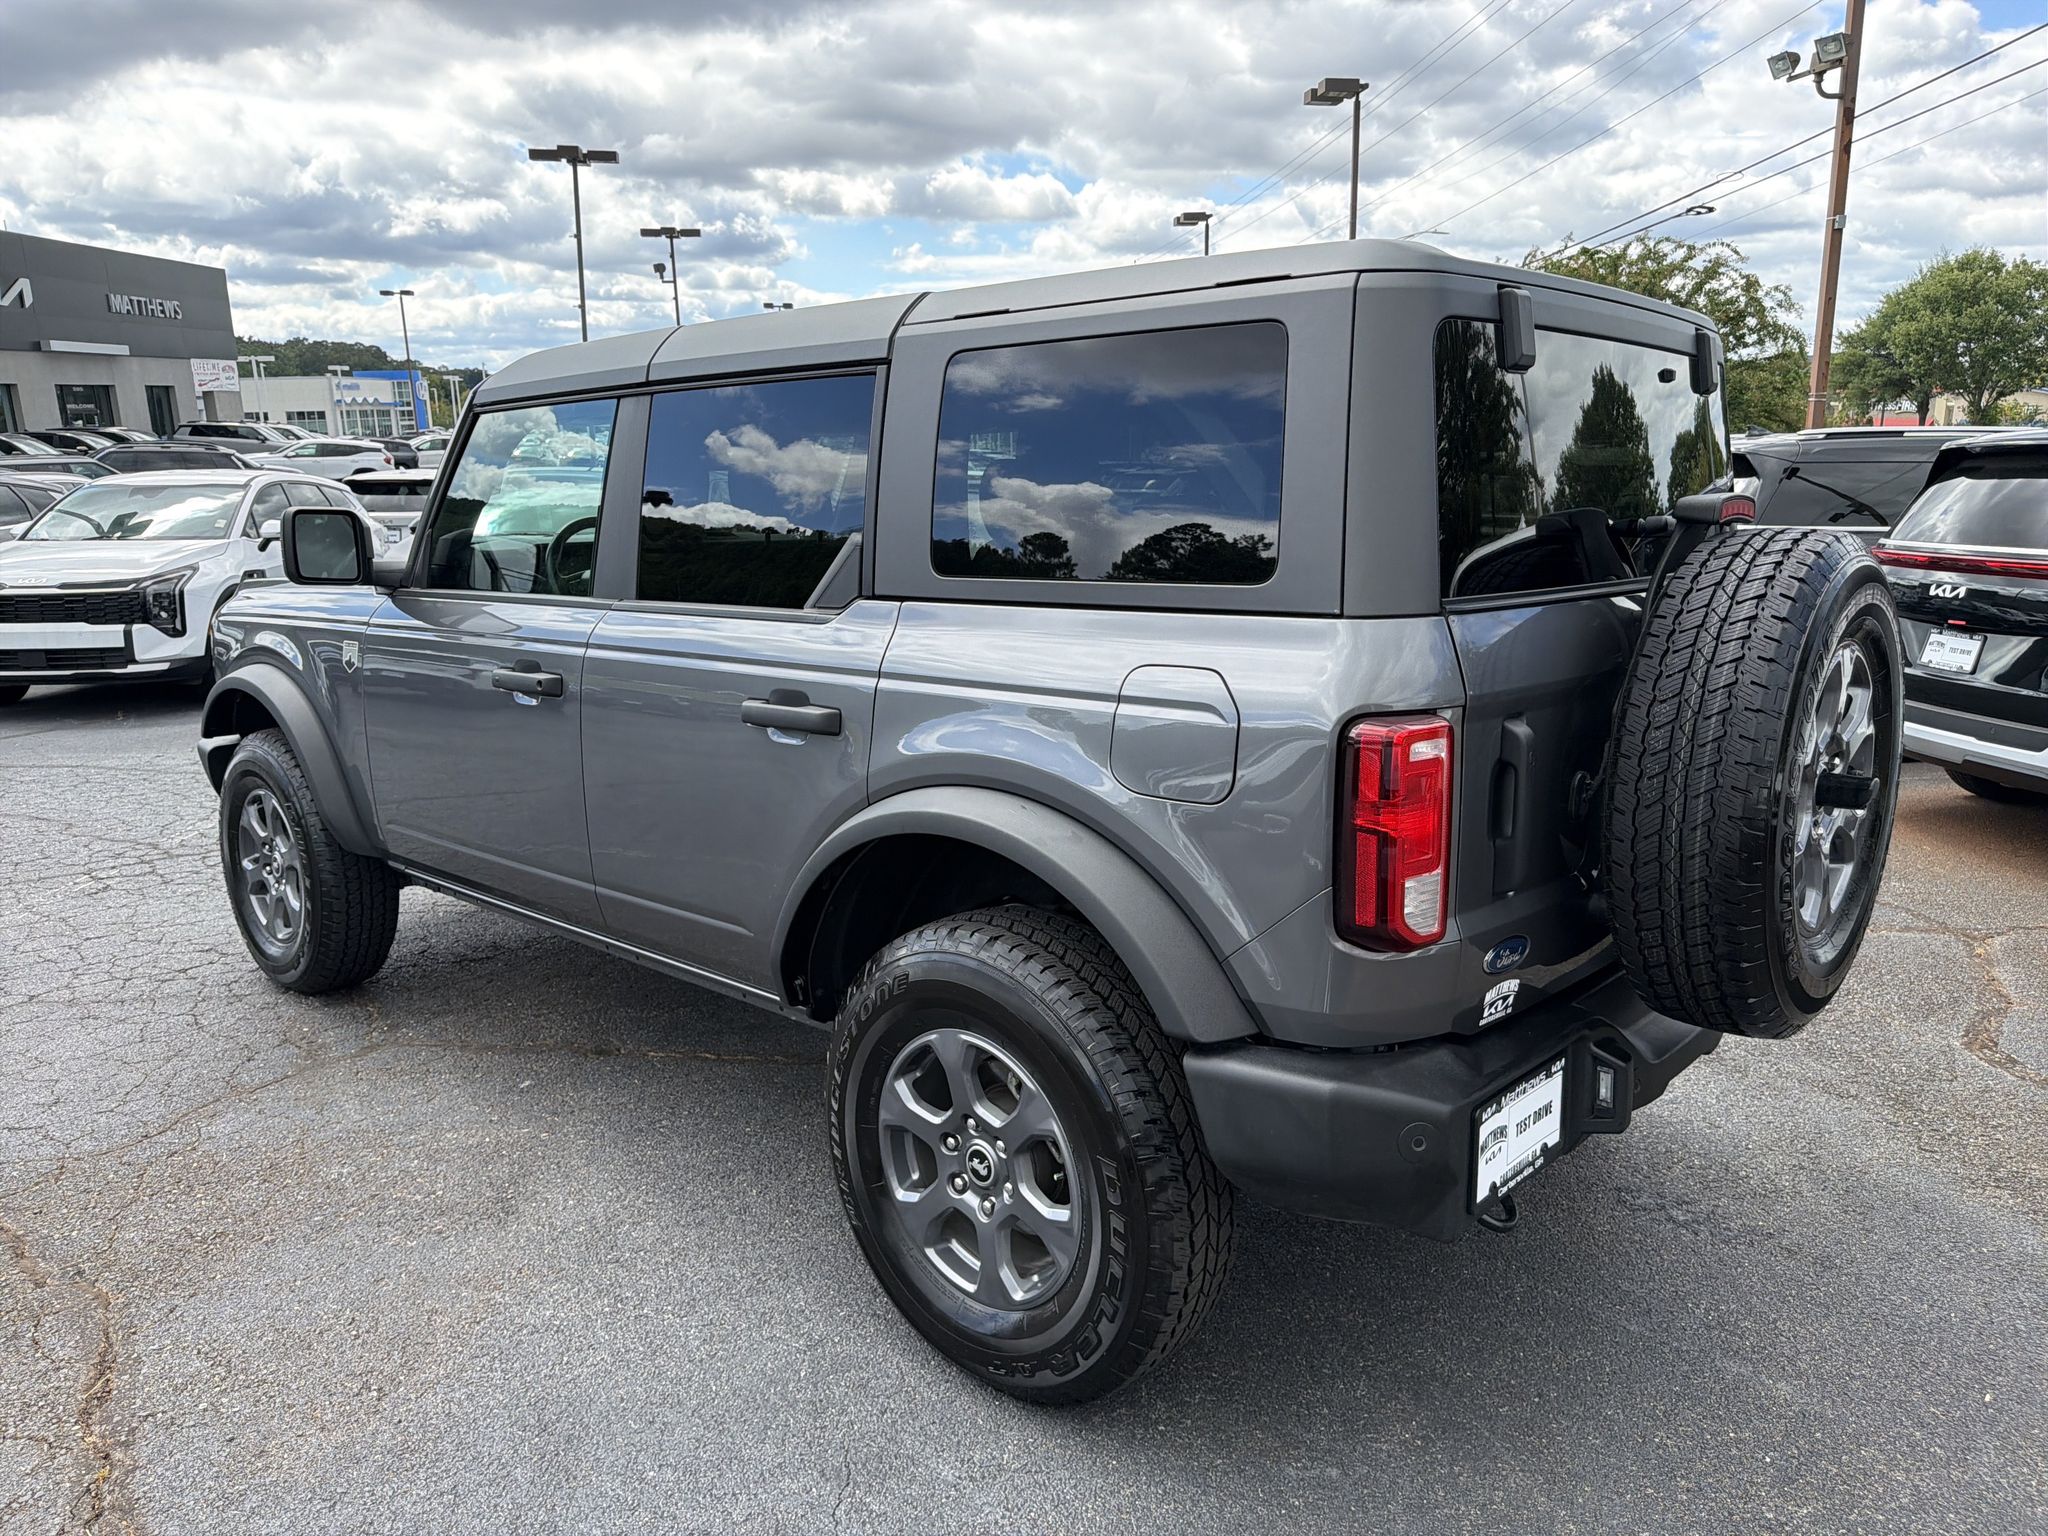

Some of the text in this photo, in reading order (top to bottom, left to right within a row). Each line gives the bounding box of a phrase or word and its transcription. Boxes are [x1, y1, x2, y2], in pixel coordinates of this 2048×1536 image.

[108, 293, 183, 320] MATTHEWS
[1928, 583, 1967, 599] KIA
[1948, 646, 1960, 655] TEST
[1960, 648, 1973, 657] DRIVE
[1483, 994, 1515, 1018] KIA
[1484, 979, 1520, 1006] MATTHEWS
[1482, 1057, 1565, 1122] KIA Matthews KIA
[1516, 1099, 1553, 1138] TEST DRIVE
[1480, 1124, 1507, 1156] MATTHEWS
[1485, 1144, 1502, 1166] KIA
[1531, 1148, 1538, 1161] GA
[1048, 1154, 1128, 1379] DUELER
